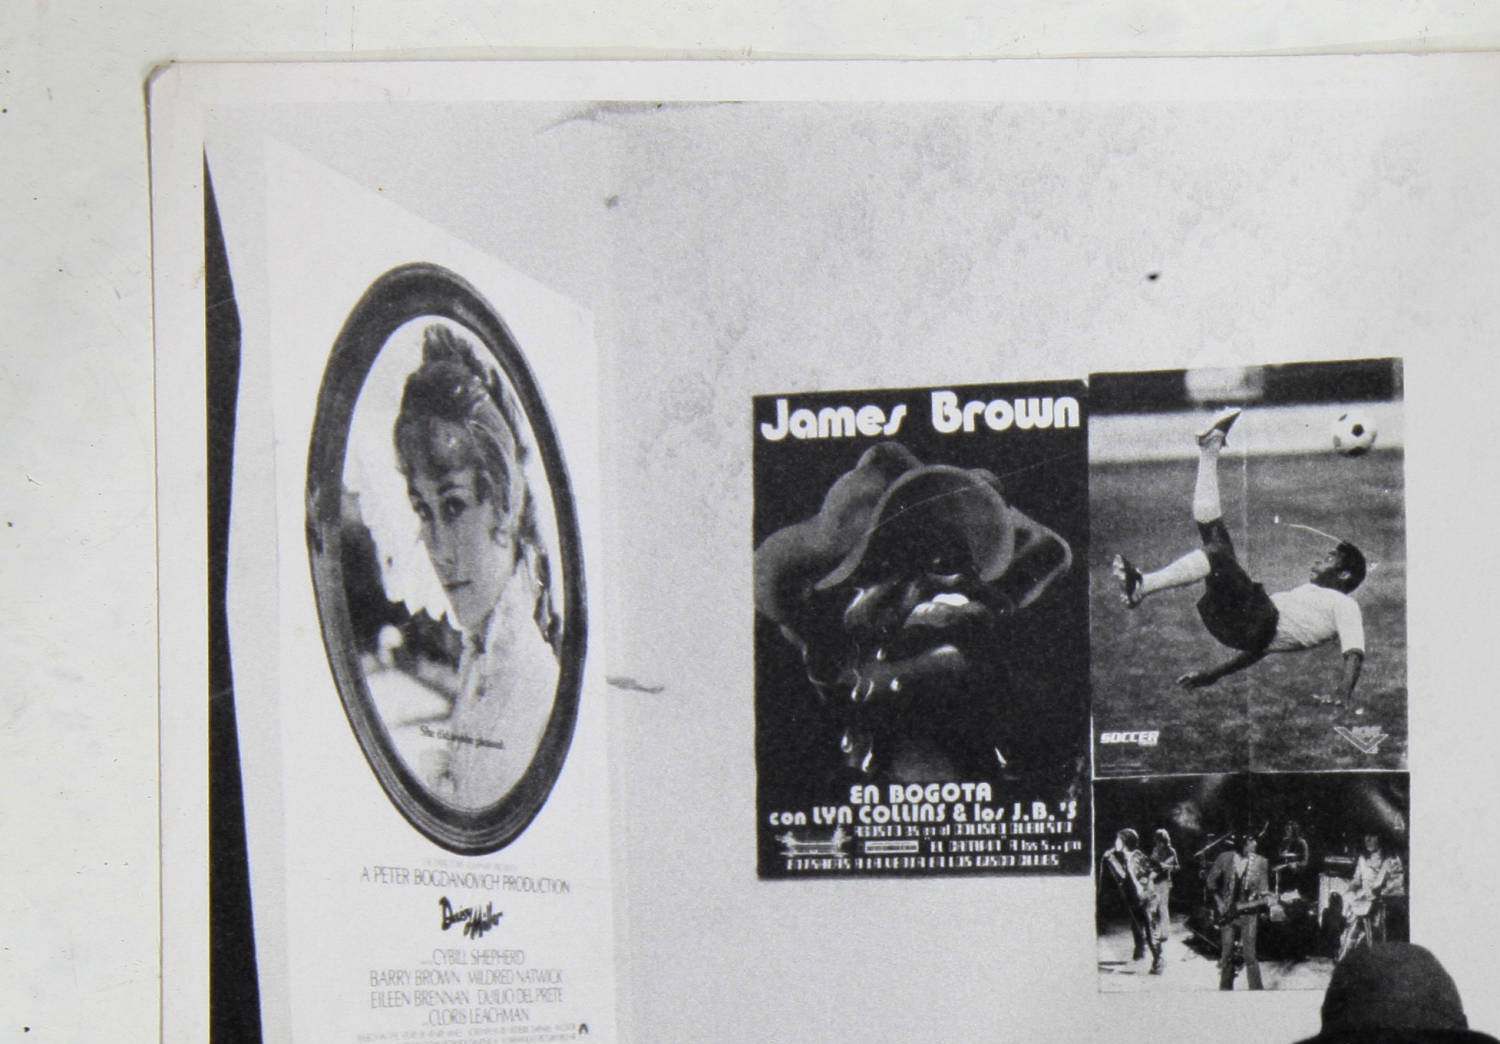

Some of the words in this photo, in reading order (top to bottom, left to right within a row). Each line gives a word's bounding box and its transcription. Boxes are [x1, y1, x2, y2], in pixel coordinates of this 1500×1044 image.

[760, 399, 907, 441] James
[931, 390, 1080, 434] Brown
[1100, 730, 1159, 746] SOCCER
[850, 784, 880, 804] EN
[889, 782, 993, 803] BOGOTA
[769, 811, 806, 826] con
[812, 805, 853, 825] LYN
[858, 803, 947, 824] COLLINS
[952, 803, 967, 823] &
[974, 802, 1005, 822] los
[361, 866, 370, 883] A
[373, 866, 410, 885] PETER
[413, 868, 500, 891] BOGDANOVICH
[502, 876, 571, 894] PRODUCTION
[369, 969, 411, 988] BARRY
[414, 969, 460, 987] BROWN
[370, 990, 411, 1009] EILEEN
[414, 990, 470, 1007] BRENNAN
[516, 987, 535, 1003] DEL
[469, 1007, 531, 1025] LEACHMAN
